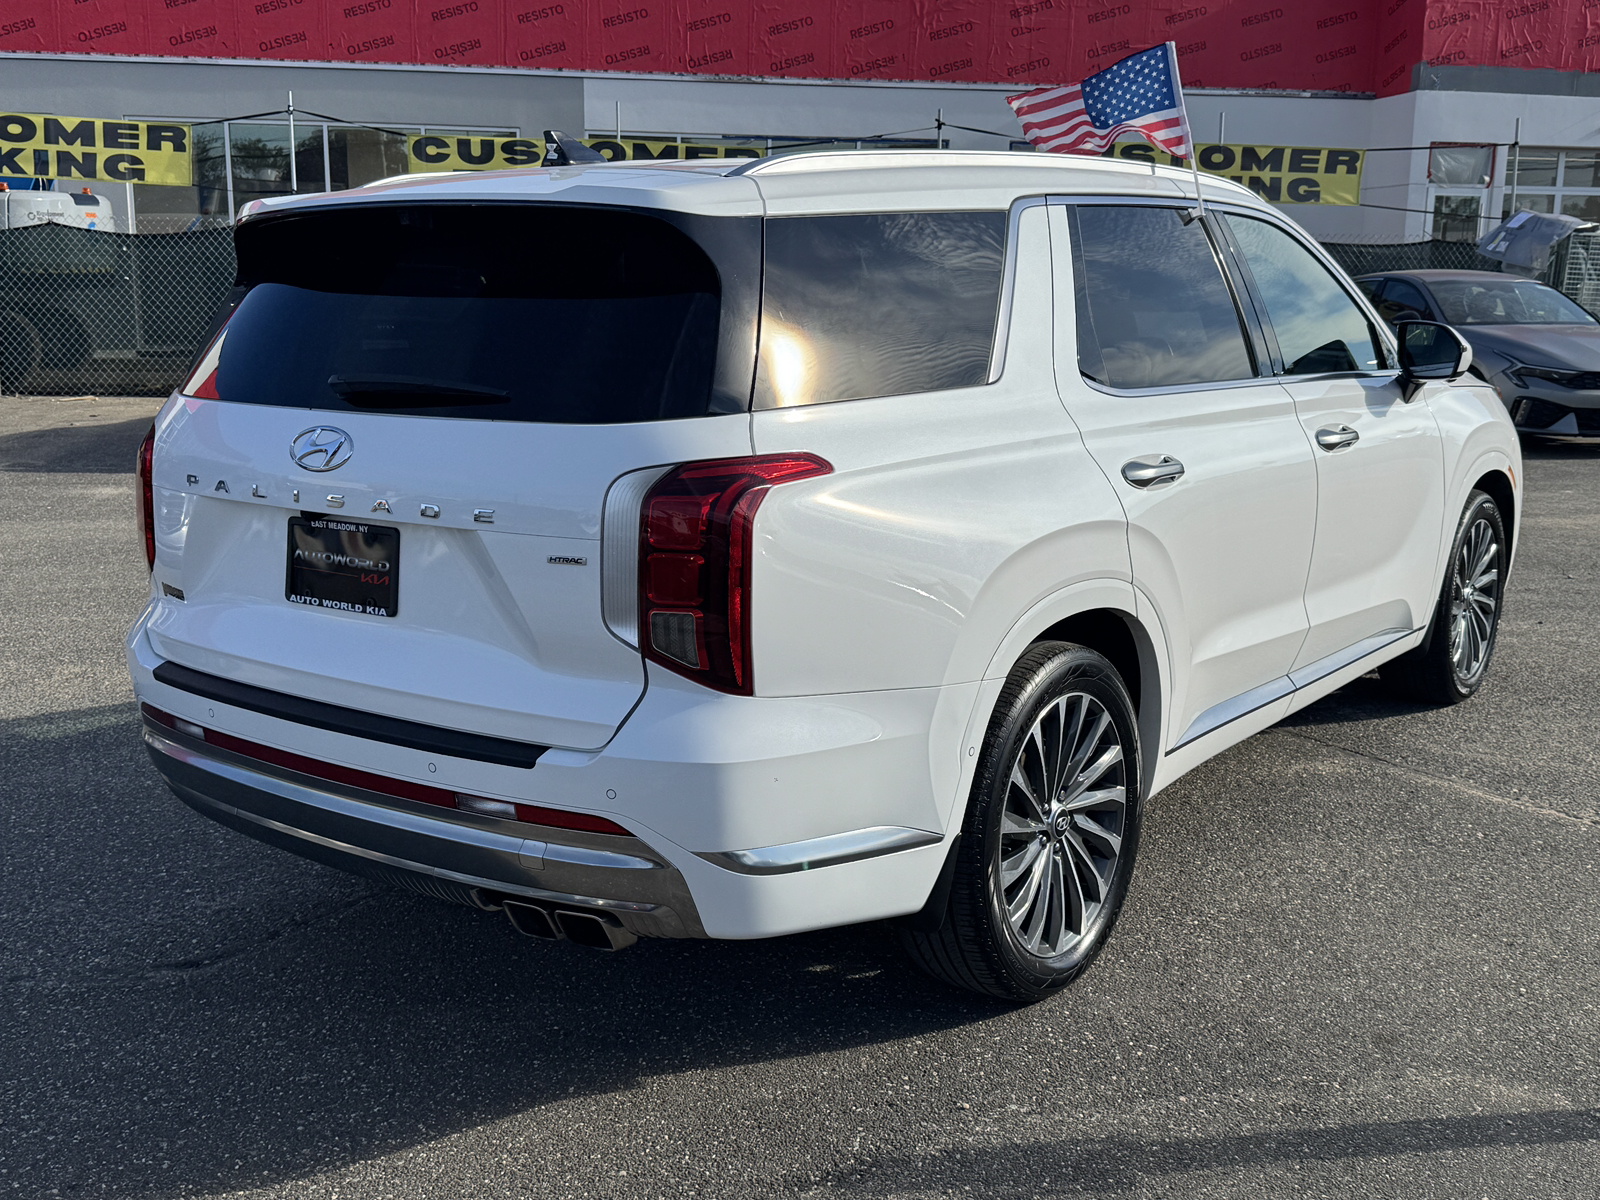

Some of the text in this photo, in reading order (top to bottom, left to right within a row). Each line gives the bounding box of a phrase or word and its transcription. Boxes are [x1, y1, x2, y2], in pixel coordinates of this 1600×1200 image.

[343, 0, 391, 19] RESISTO
[431, 1, 479, 22] RESISTO
[517, 4, 565, 25] RESISTO
[602, 8, 649, 29] RESISTO
[1009, 0, 1053, 19] RESISTO
[1087, 4, 1131, 24] RESISTO
[1165, 6, 1208, 26] RESISTO
[1241, 8, 1284, 28] RESISTO
[1506, 1, 1549, 20] RESISTO
[686, 12, 732, 33] RESISTO
[768, 16, 814, 37] RESISTO
[850, 19, 895, 40] RESISTO
[1316, 11, 1358, 30] RESISTO
[1428, 10, 1470, 30] RESISTO
[78, 21, 127, 42] RESISTO
[169, 25, 218, 46] RESISTO
[258, 30, 307, 52] RESISTO
[929, 22, 973, 42] RESISTO
[346, 35, 395, 56] RESISTO
[434, 38, 482, 59] RESISTO
[519, 41, 567, 62] RESISTO
[605, 45, 650, 65] RESISTO
[1087, 39, 1130, 59] RESISTO
[1240, 42, 1282, 62] RESISTO
[1315, 44, 1357, 64] RESISTO
[1501, 40, 1543, 59] RESISTO
[688, 49, 733, 69] RESISTO
[770, 52, 815, 73] RESISTO
[851, 55, 895, 76] RESISTO
[929, 58, 973, 78] RESISTO
[1427, 50, 1466, 68] ESISTO
[0, 115, 187, 153] OMER
[0, 147, 146, 182] KING
[186, 473, 495, 524] PALISADE
[311, 520, 327, 529] EAST
[358, 525, 369, 534] NY
[549, 556, 583, 565] HTRAC
[361, 573, 390, 586] KIA
[289, 594, 387, 617] AUTO WORLD KIA
